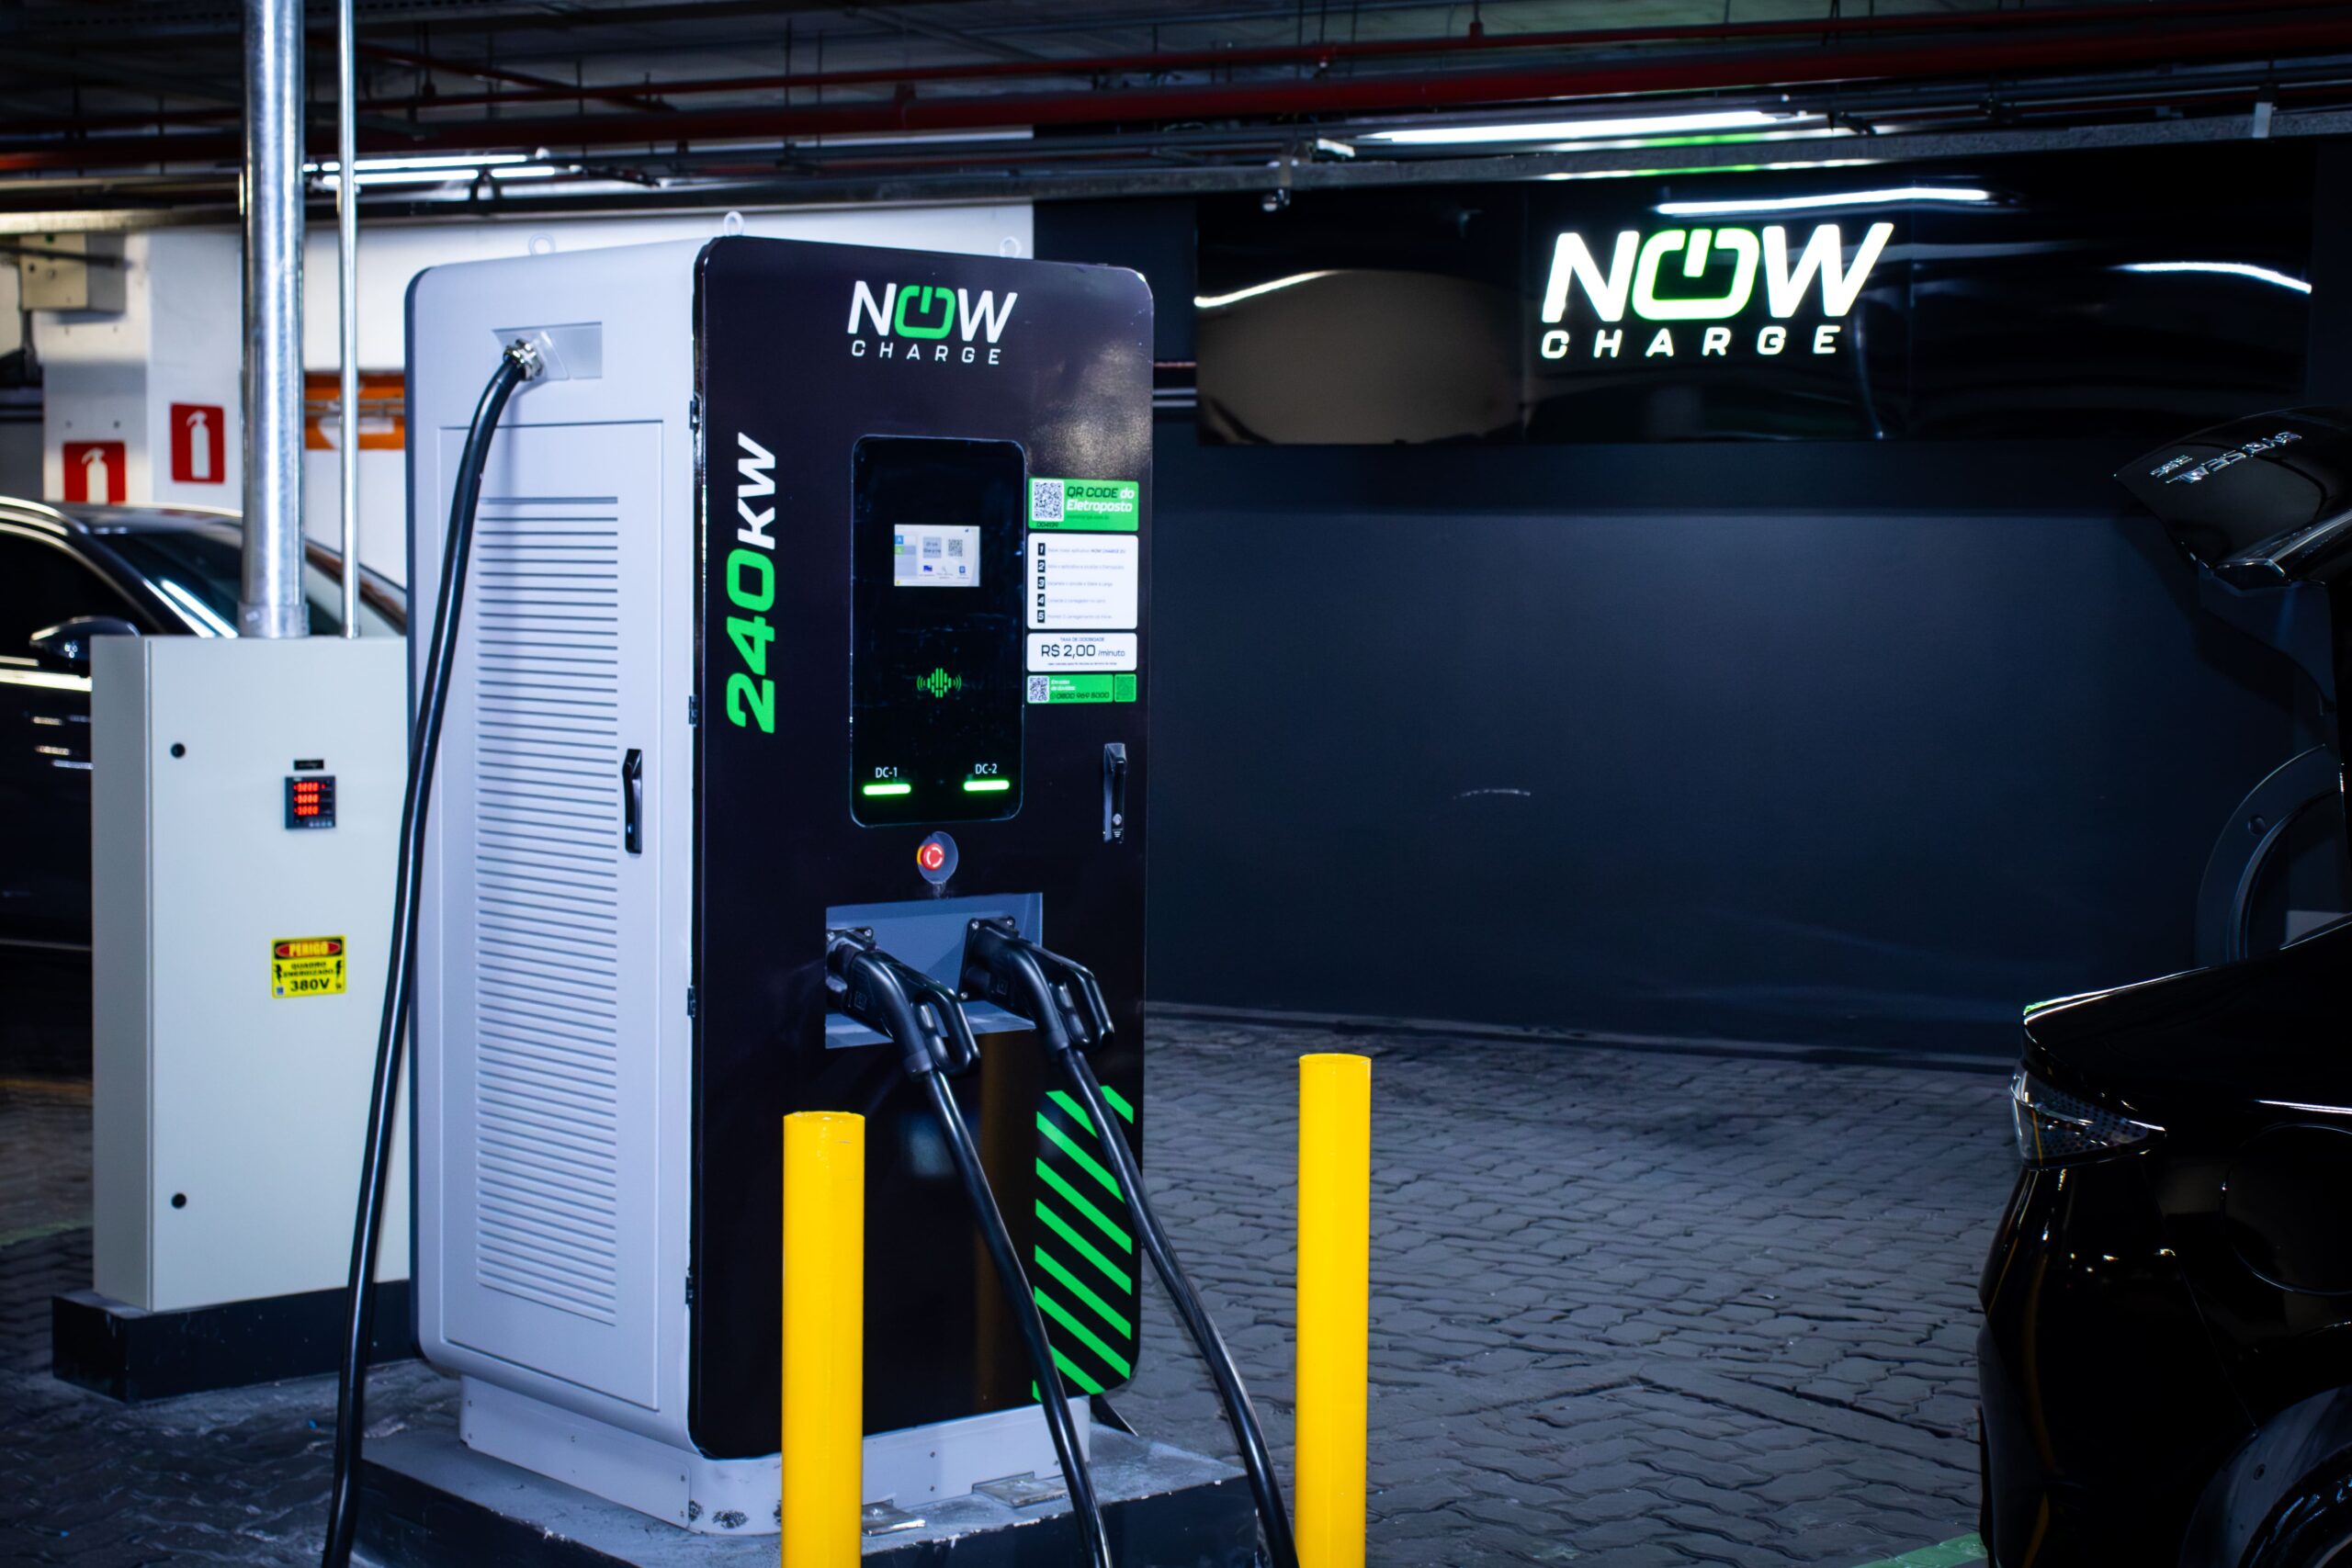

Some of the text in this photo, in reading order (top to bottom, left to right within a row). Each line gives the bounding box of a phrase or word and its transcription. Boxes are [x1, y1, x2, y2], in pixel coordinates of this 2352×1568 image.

[1541, 221, 1894, 323] NOW
[847, 280, 1018, 344] NOW
[1541, 325, 1841, 359] CHARGE
[852, 340, 1001, 365] CHARGE
[1067, 486, 1135, 499] QR CODE do
[1066, 499, 1133, 514] Eletroposto
[1041, 644, 1060, 658] R$
[1063, 644, 1096, 660] 2,00
[875, 766, 898, 778] DC-1
[975, 762, 998, 774] DC-2
[288, 941, 328, 957] PERIGO
[290, 977, 330, 992] 380V
